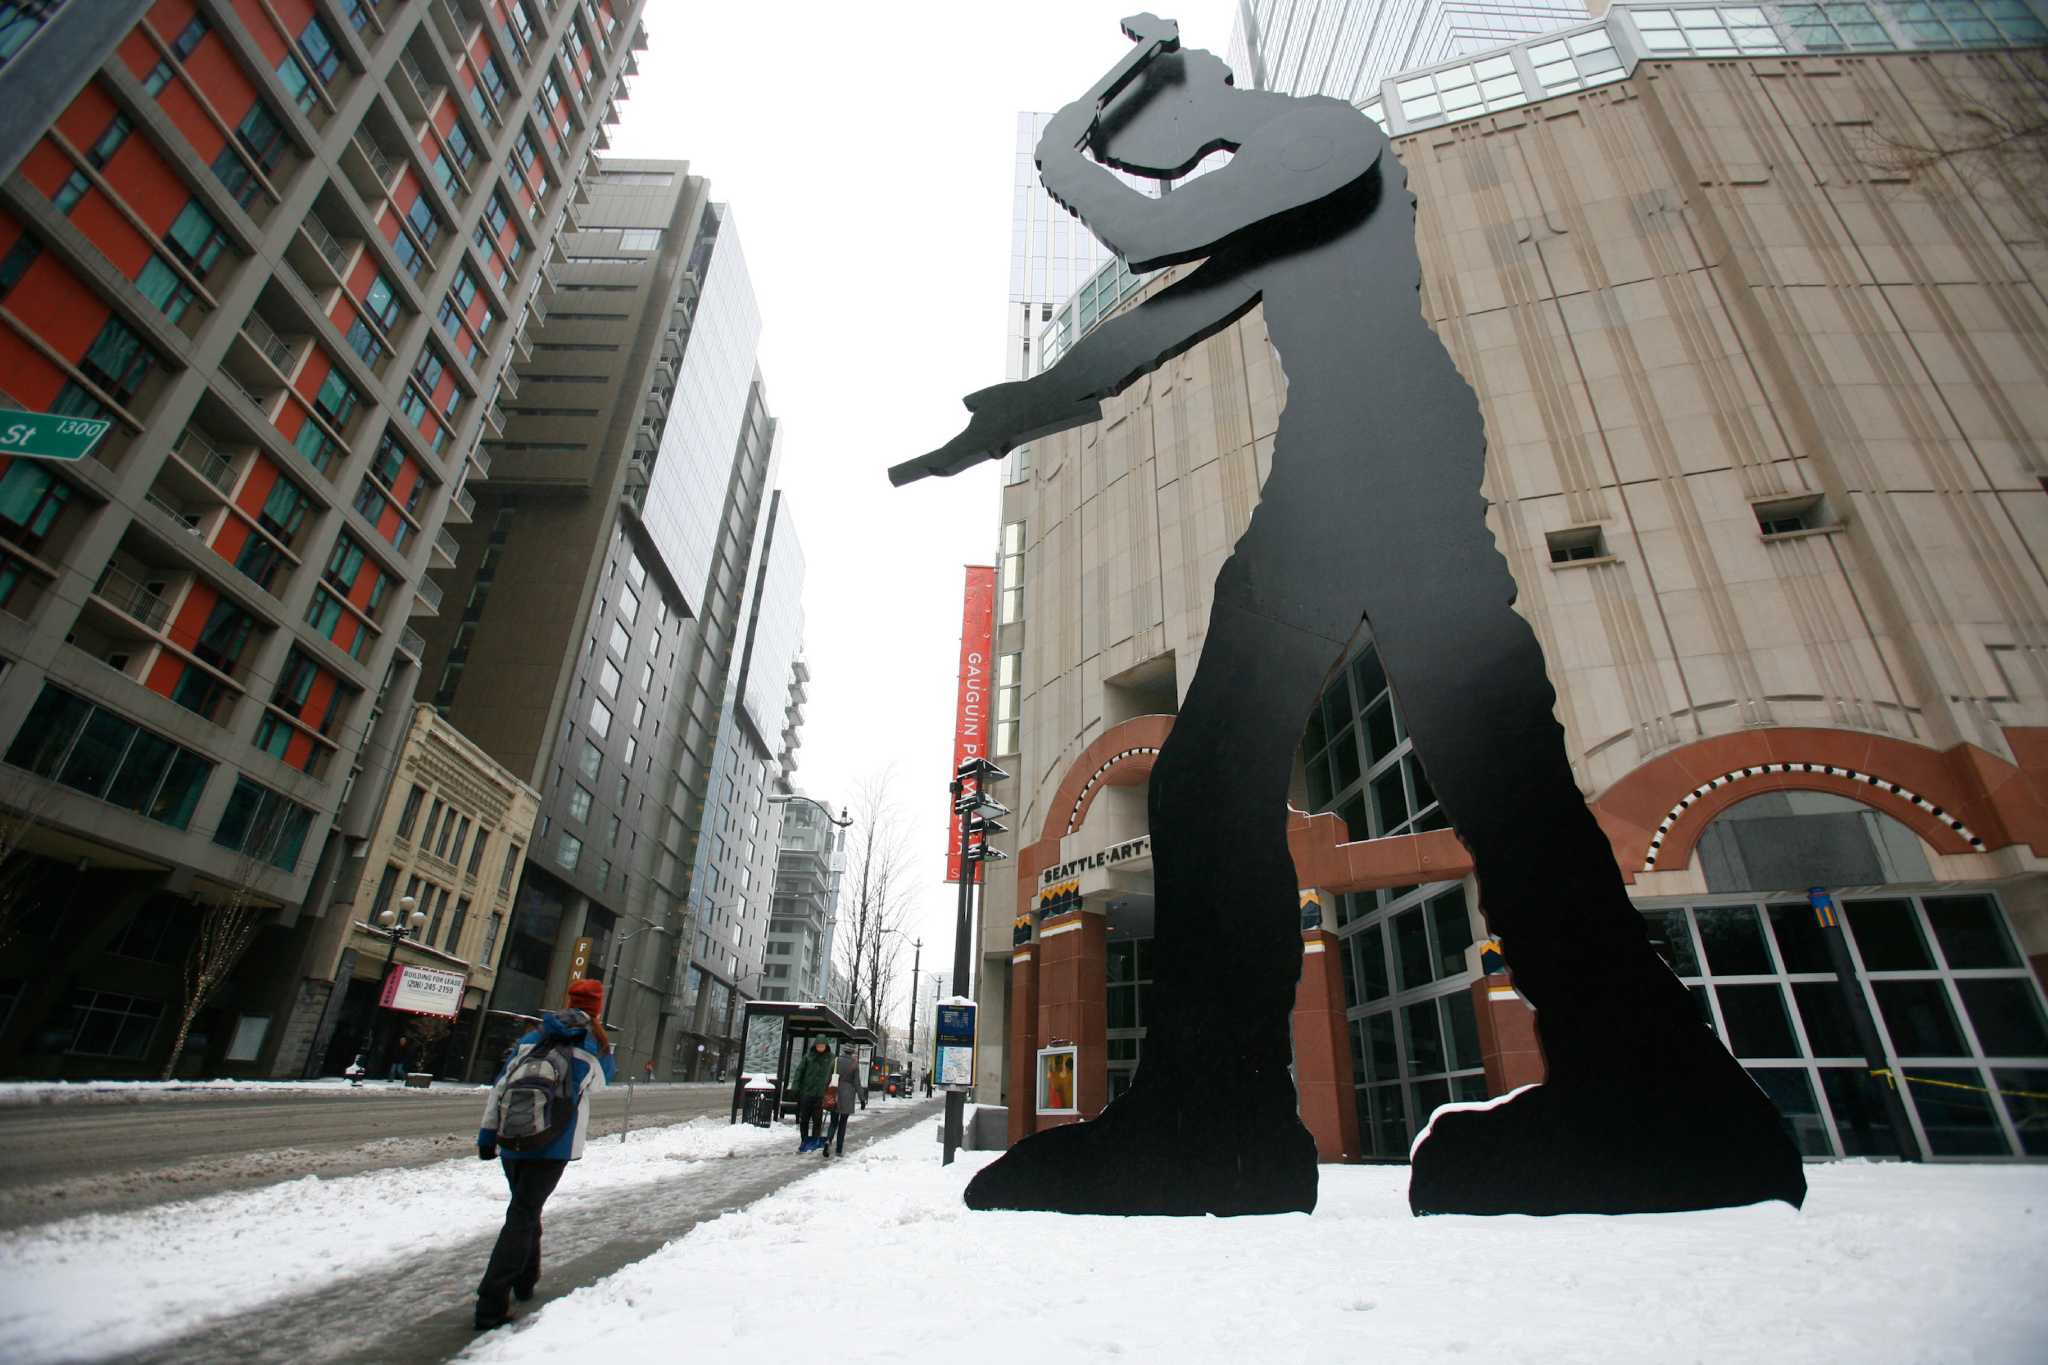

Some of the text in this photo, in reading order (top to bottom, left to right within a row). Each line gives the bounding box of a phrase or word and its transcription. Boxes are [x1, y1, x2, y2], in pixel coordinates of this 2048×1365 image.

[0, 420, 101, 446] St 1300
[963, 652, 982, 736] GAUGUIN
[1044, 841, 1144, 883] SEATTLE ART
[403, 970, 461, 987] BUILDING FOR LEASE
